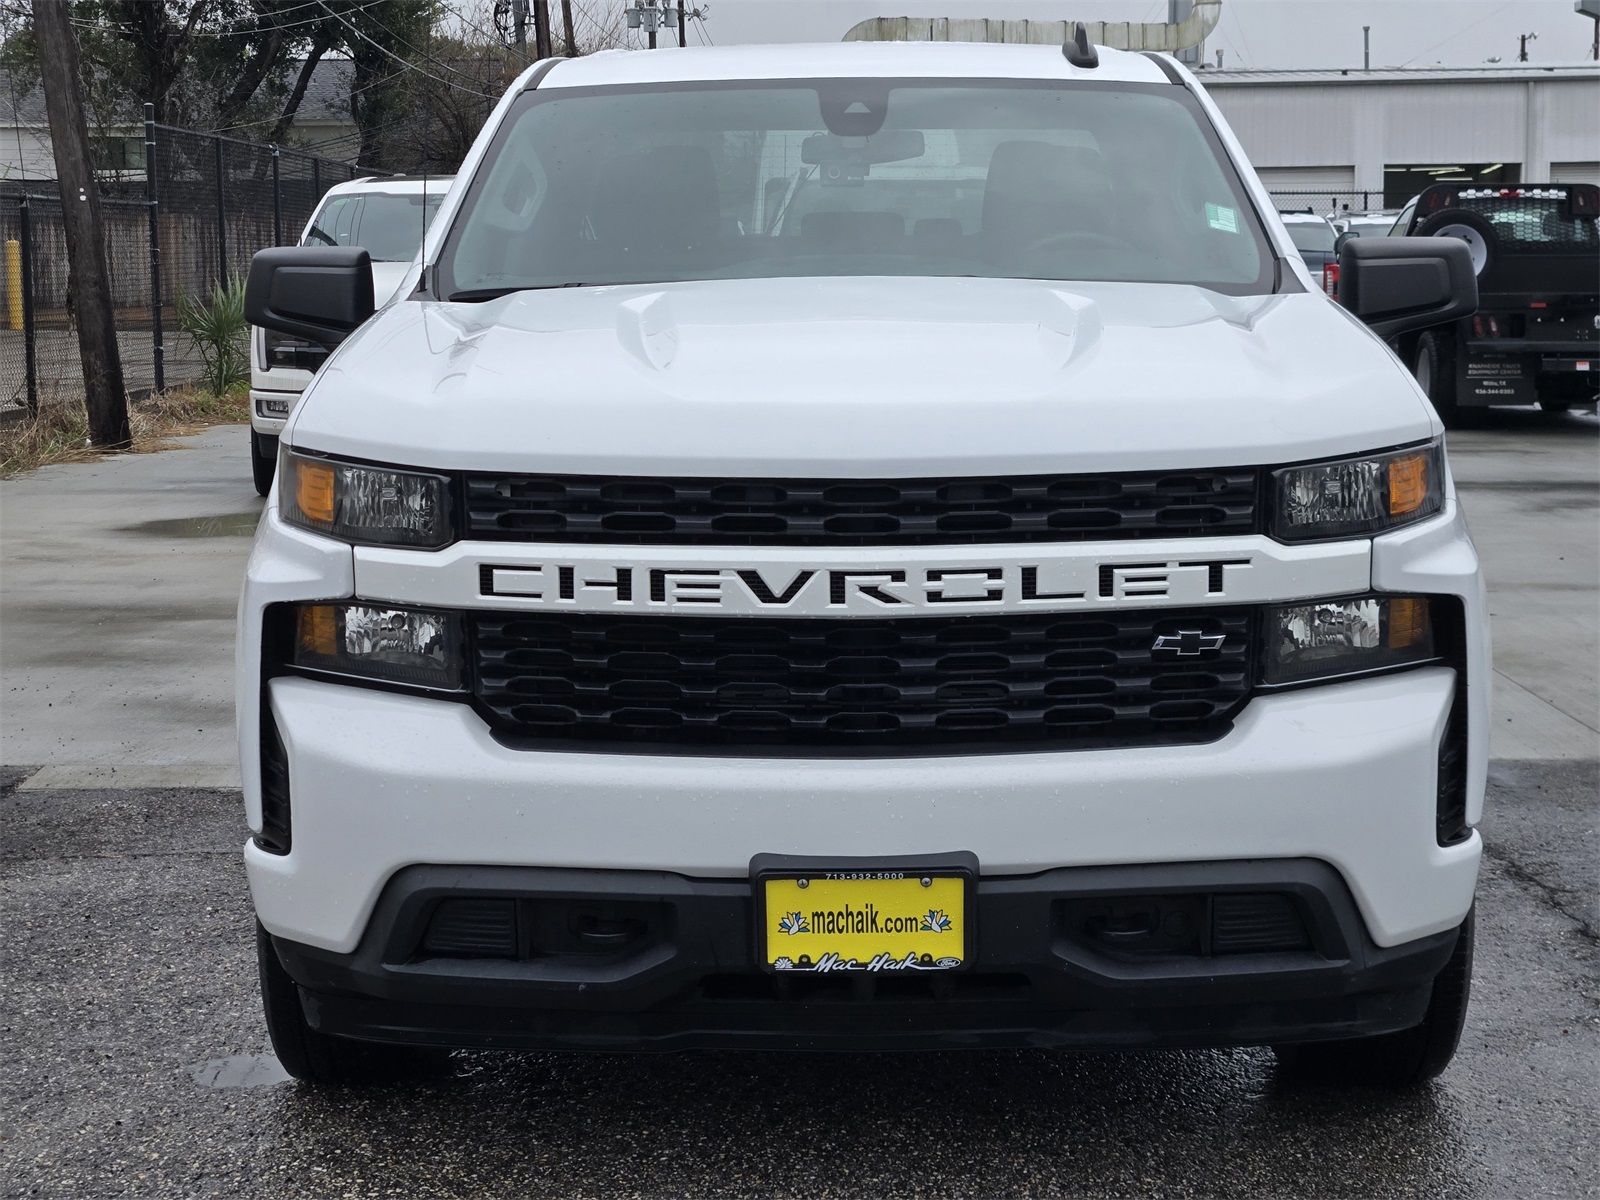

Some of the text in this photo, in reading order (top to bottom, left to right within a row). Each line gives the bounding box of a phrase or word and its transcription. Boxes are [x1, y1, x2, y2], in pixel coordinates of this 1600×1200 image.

[478, 558, 1253, 605] CHEVROLET
[811, 903, 919, 934] machaik.com
[813, 952, 920, 973] Mac Haik
[940, 959, 957, 967] Ford
